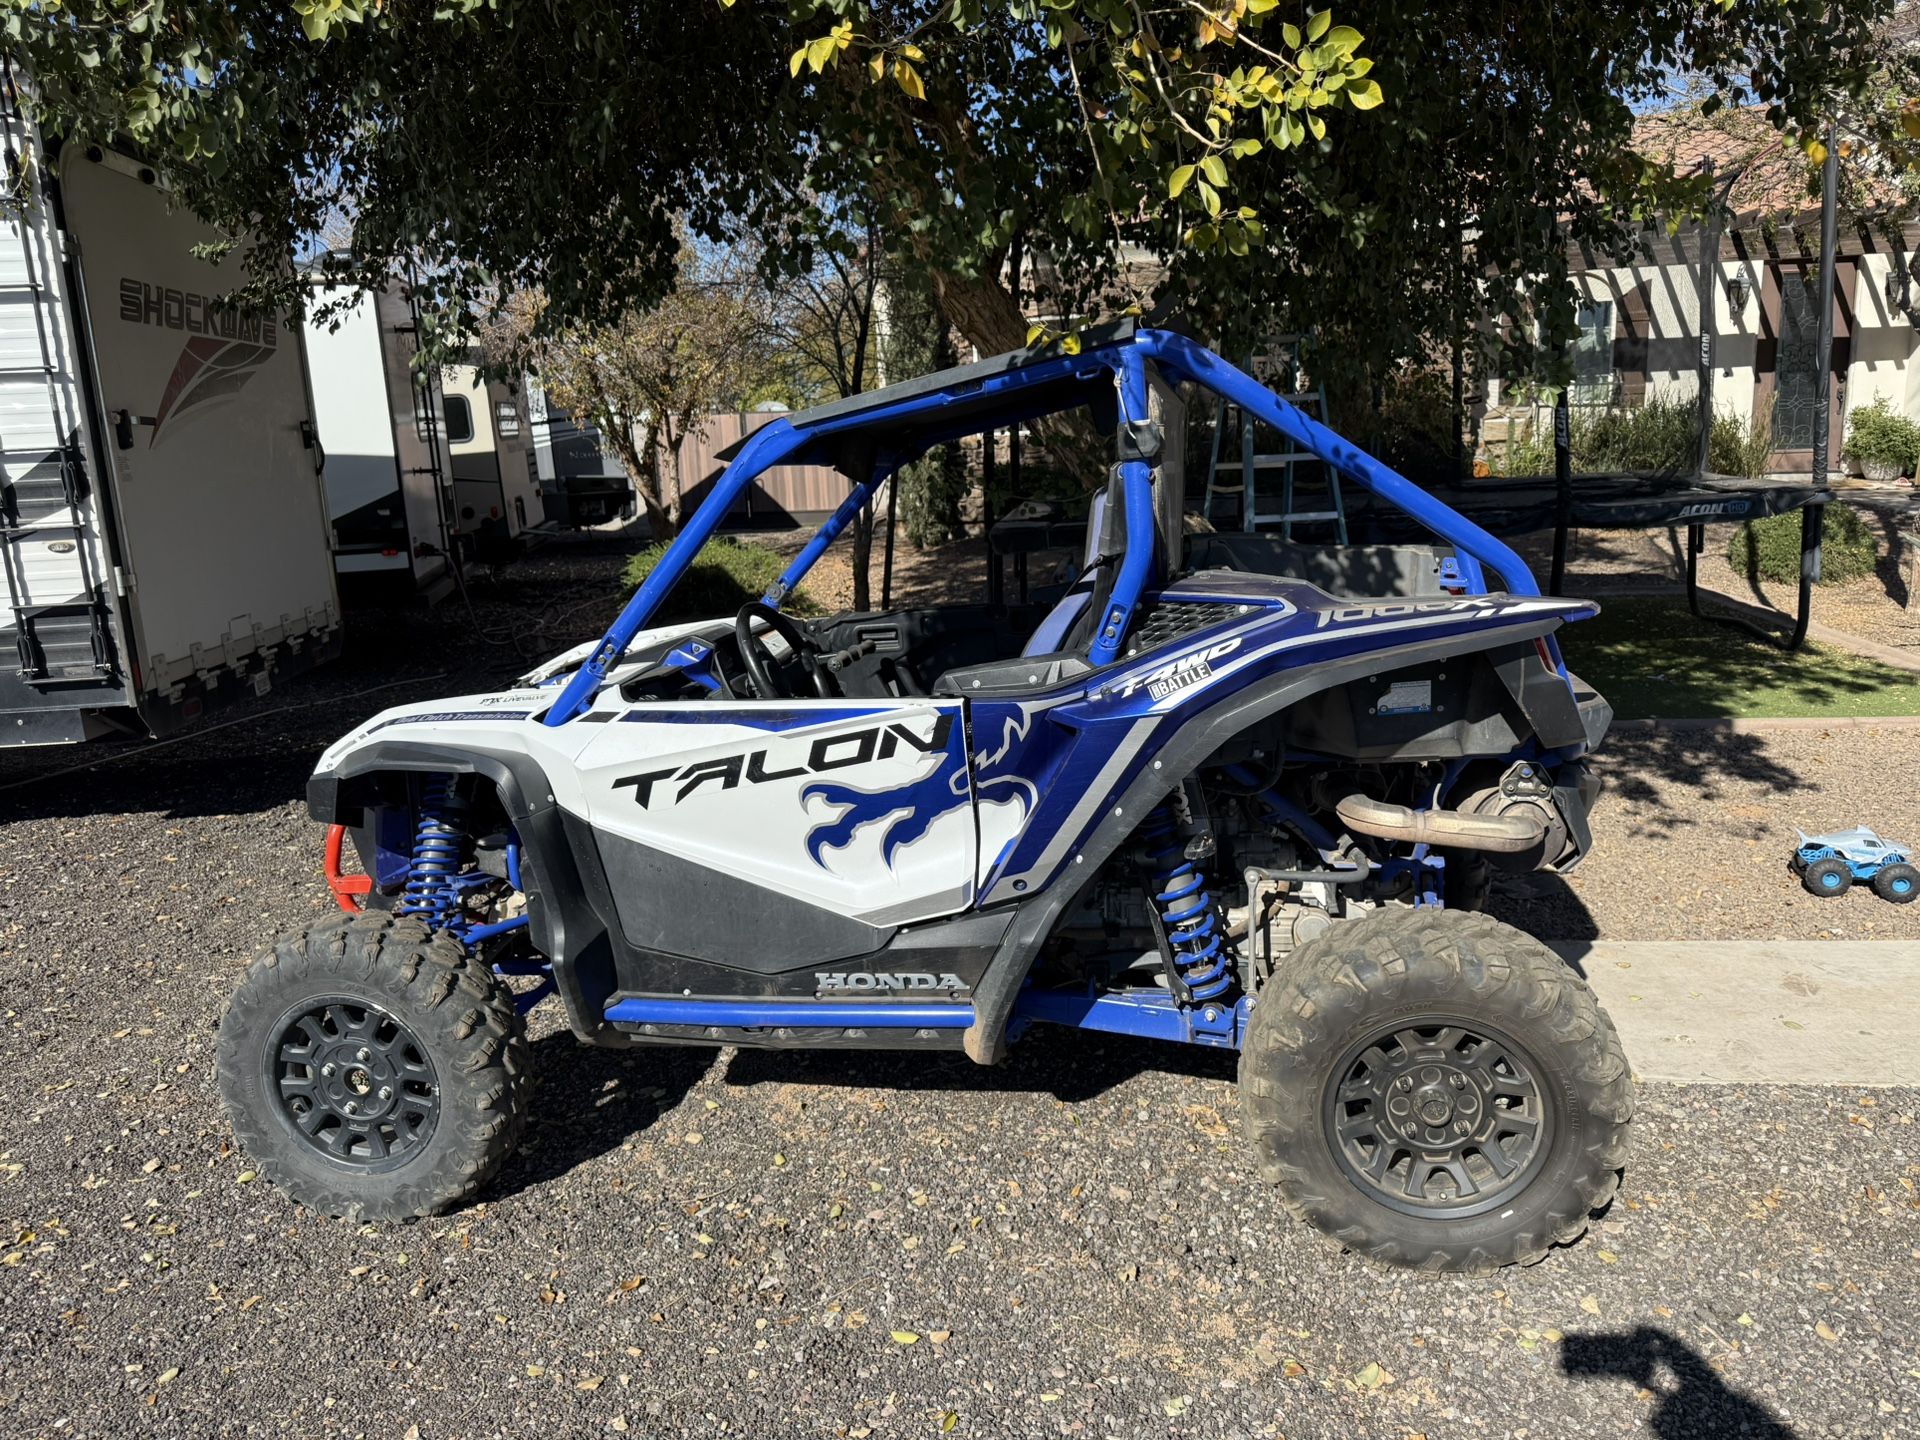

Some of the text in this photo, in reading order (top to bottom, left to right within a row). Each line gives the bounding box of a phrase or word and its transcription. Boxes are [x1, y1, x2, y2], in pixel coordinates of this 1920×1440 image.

[119, 277, 278, 347] SHOCKWAVE
[1679, 503, 1724, 516] ACON
[1317, 597, 1493, 628] 1000X
[1159, 667, 1209, 695] BATTLE
[420, 713, 452, 722] Clutch
[454, 711, 526, 721] Transmission
[612, 714, 955, 811] TALON
[815, 972, 971, 990] HONDA
